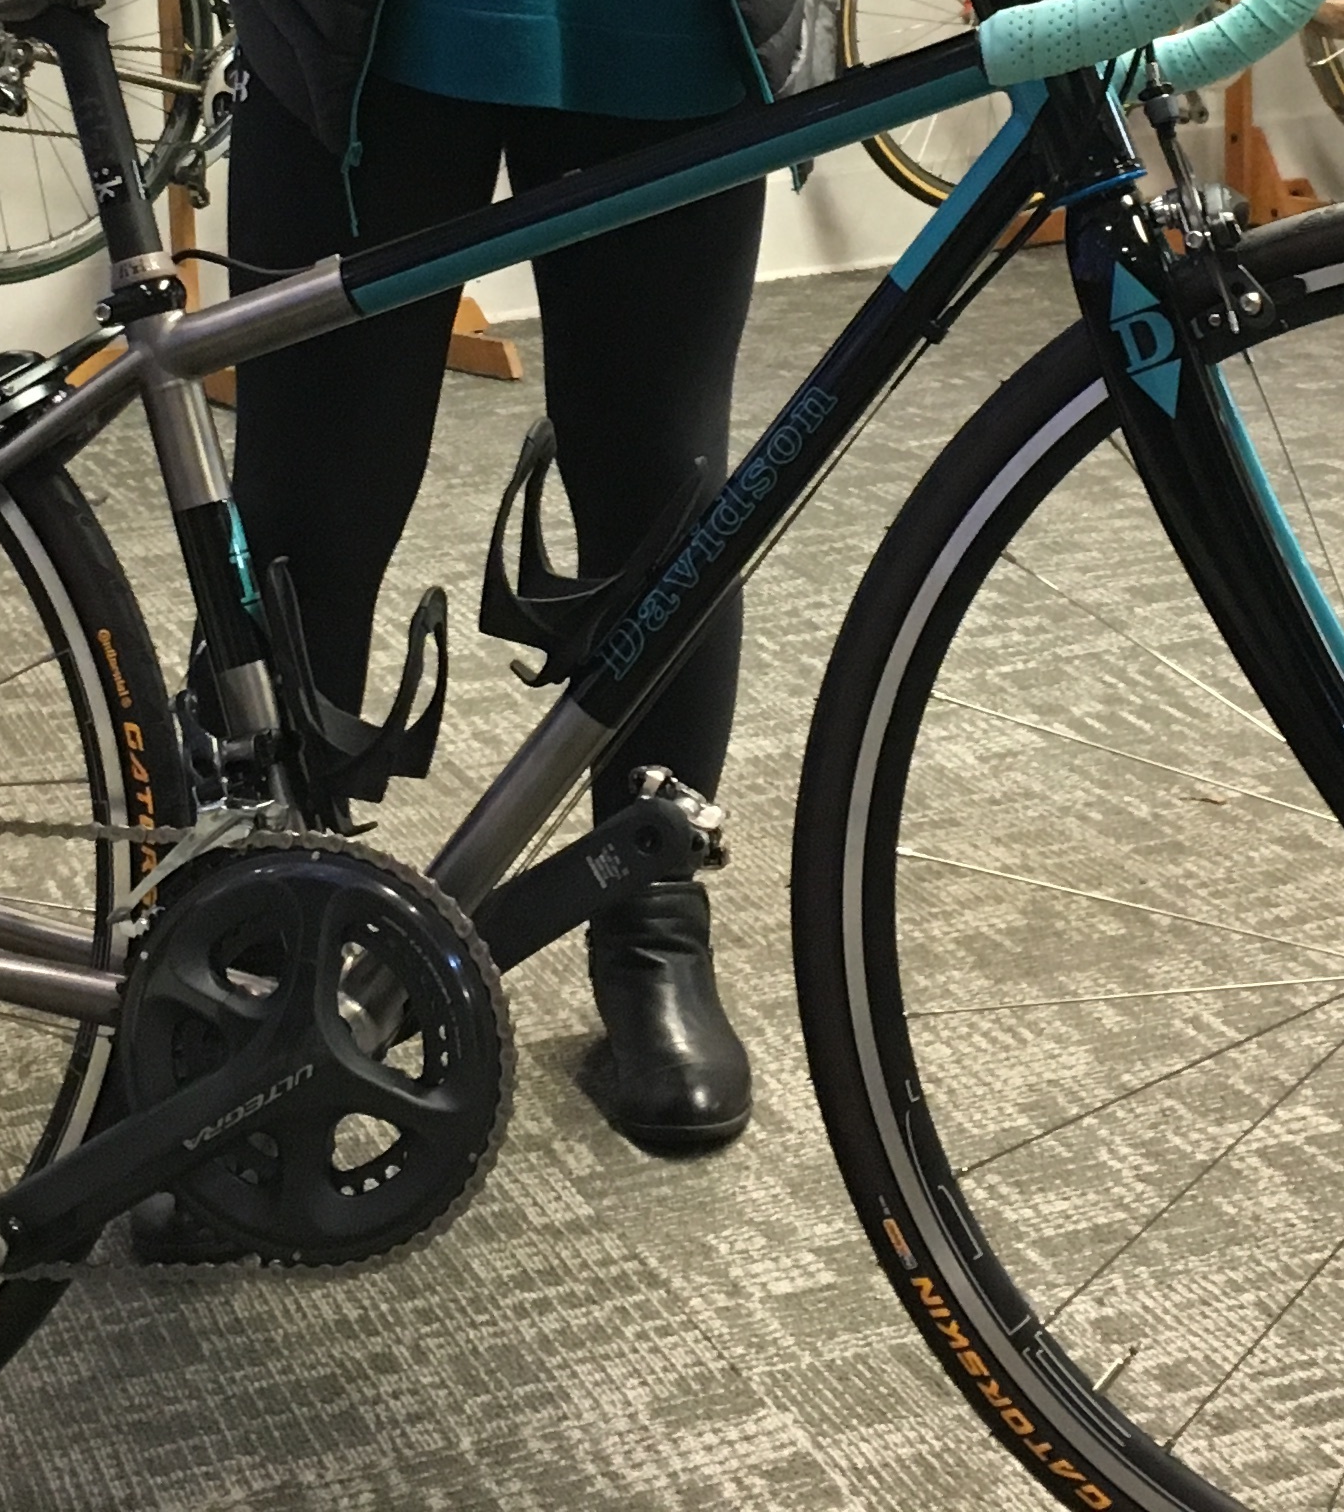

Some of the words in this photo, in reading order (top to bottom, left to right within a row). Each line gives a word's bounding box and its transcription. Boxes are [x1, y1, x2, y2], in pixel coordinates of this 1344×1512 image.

[1109, 310, 1176, 374] D
[596, 384, 840, 681] Davidson
[96, 628, 130, 698] Continental
[183, 1063, 314, 1152] ULTEGRA
[910, 1276, 1113, 1511] GATORSKIN
